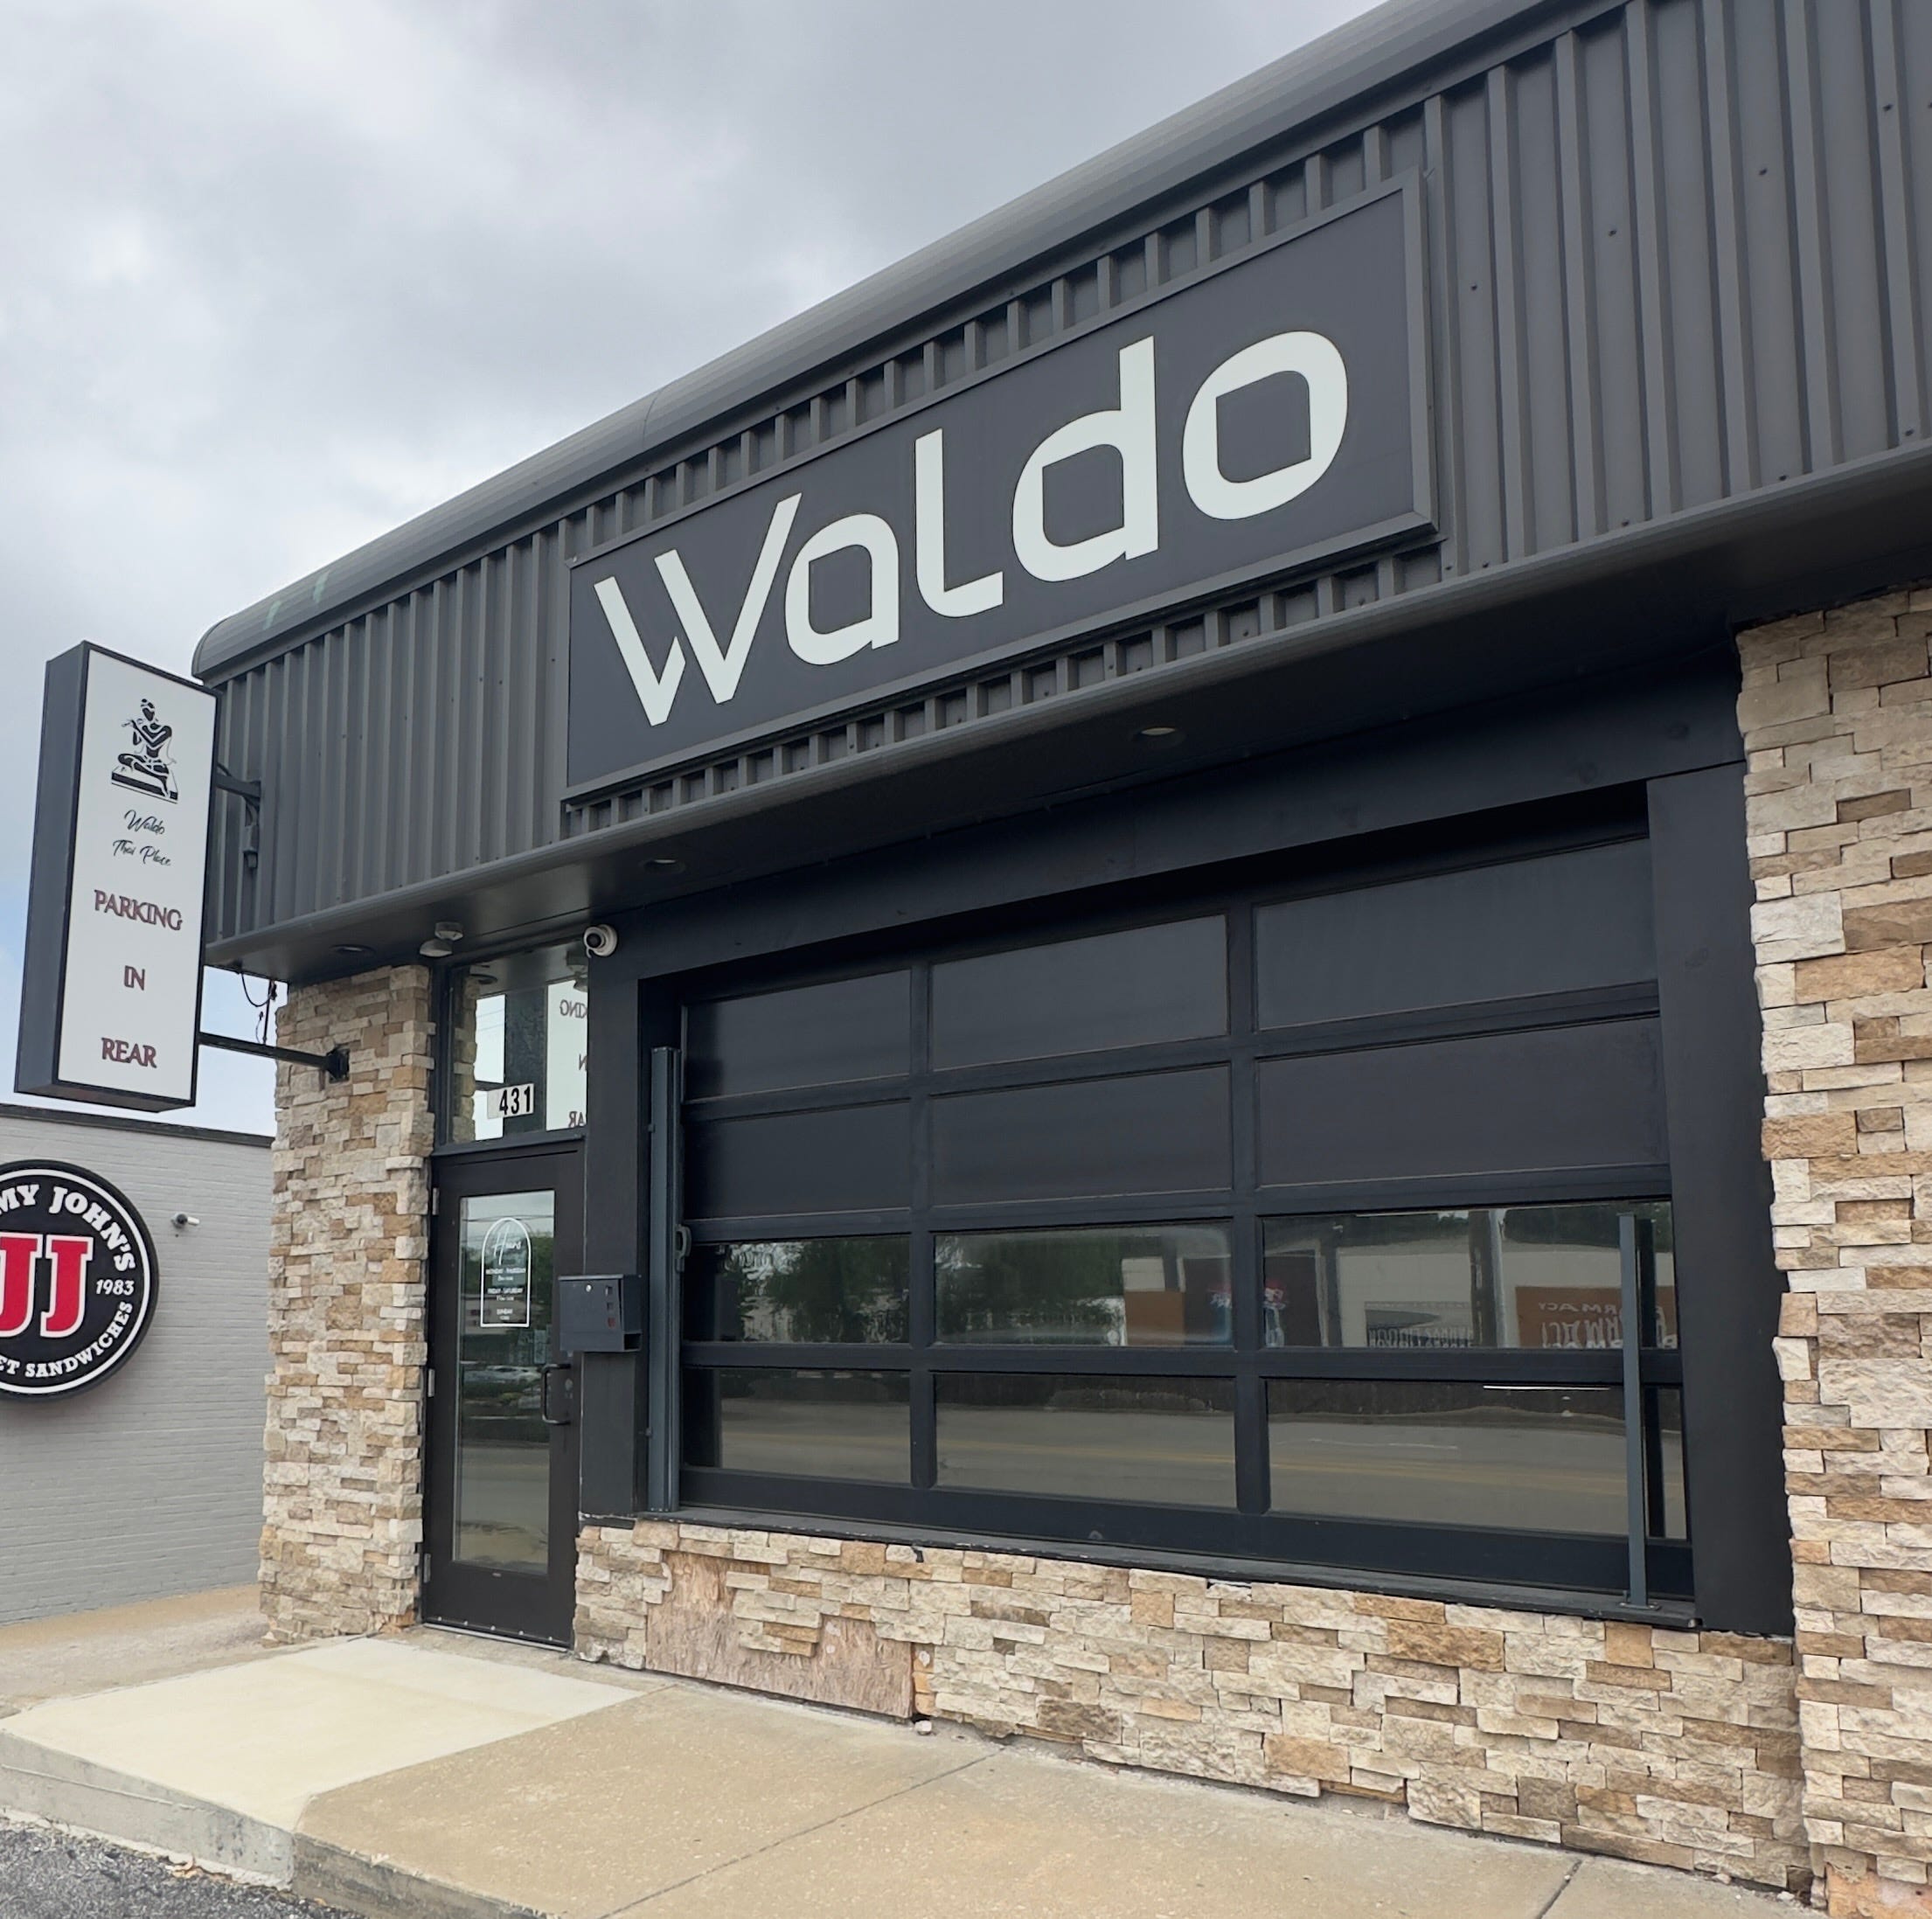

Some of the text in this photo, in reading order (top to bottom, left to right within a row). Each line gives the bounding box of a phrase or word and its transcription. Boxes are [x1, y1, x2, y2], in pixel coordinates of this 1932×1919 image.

[124, 809, 165, 835] Waldo
[94, 889, 183, 931] PARKING
[124, 965, 145, 991] IN
[101, 1037, 157, 1068] REAR
[498, 1085, 532, 1116] 431
[49, 1185, 136, 1272] JOHN'S
[95, 1279, 135, 1296] 1983
[24, 1301, 133, 1378] SANDWICHES
